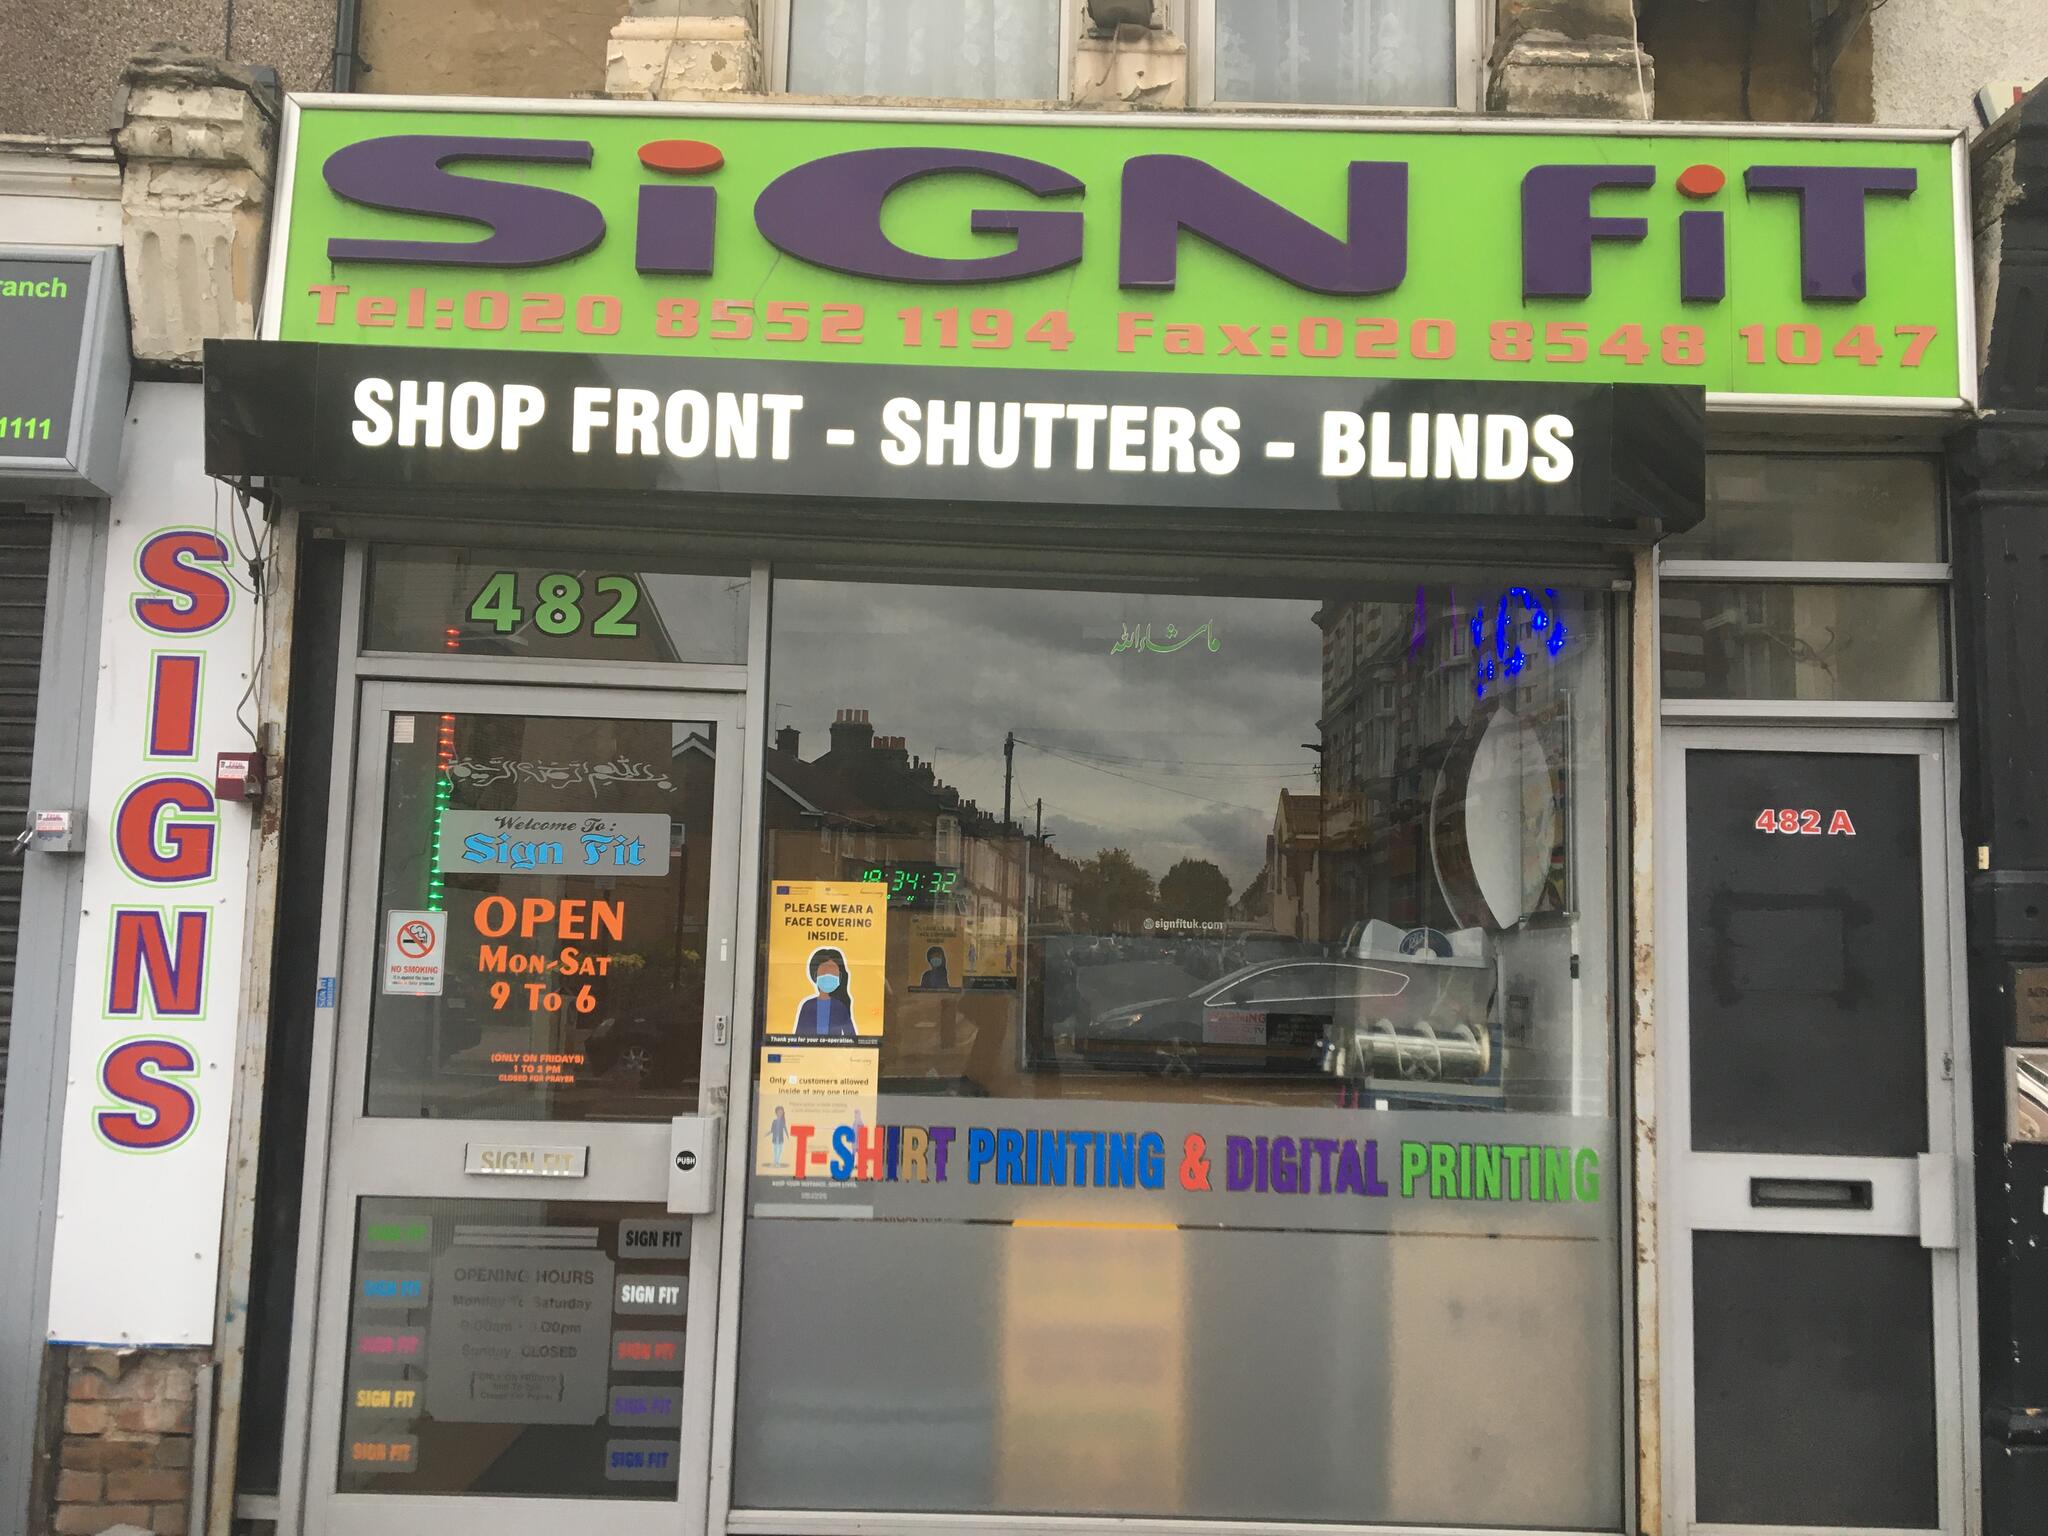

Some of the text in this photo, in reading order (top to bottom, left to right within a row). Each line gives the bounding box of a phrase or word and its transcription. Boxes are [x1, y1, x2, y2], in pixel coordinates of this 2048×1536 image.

[308, 284, 1937, 367] Tel:020 8552 1194 Fax:020 8548 1047
[352, 377, 545, 450] SHOP
[572, 386, 803, 460] FRONT
[880, 396, 1241, 475] SHUTTERS
[1321, 410, 1574, 483] BLINDS
[466, 571, 640, 637] 482
[494, 816, 576, 831] Welcome
[1755, 809, 1856, 835] 482 A
[92, 525, 236, 1155] SIGNS
[462, 832, 645, 870] Sign Fit
[784, 903, 873, 914] PLEASE WEAR A
[474, 896, 624, 941] OPEN
[785, 917, 872, 928] FACE COVERING
[808, 931, 848, 941] INSIDE.
[391, 965, 438, 974] NO SMOKING
[490, 982, 510, 1009] 9
[576, 985, 596, 1013] 6
[522, 1054, 537, 1062] ON
[481, 1151, 577, 1175] SIGN FIT
[677, 1156, 695, 1165] PUSH
[790, 1125, 1599, 1202] T-SHIRT PRINTING & DIGITAL PRINTING
[626, 1230, 682, 1247] SIGN FIT
[536, 1270, 594, 1285] HOURS
[621, 1285, 680, 1304] SIGN FIT
[521, 1345, 577, 1358] CLOSED
[356, 1390, 415, 1408] SIGN FIT
